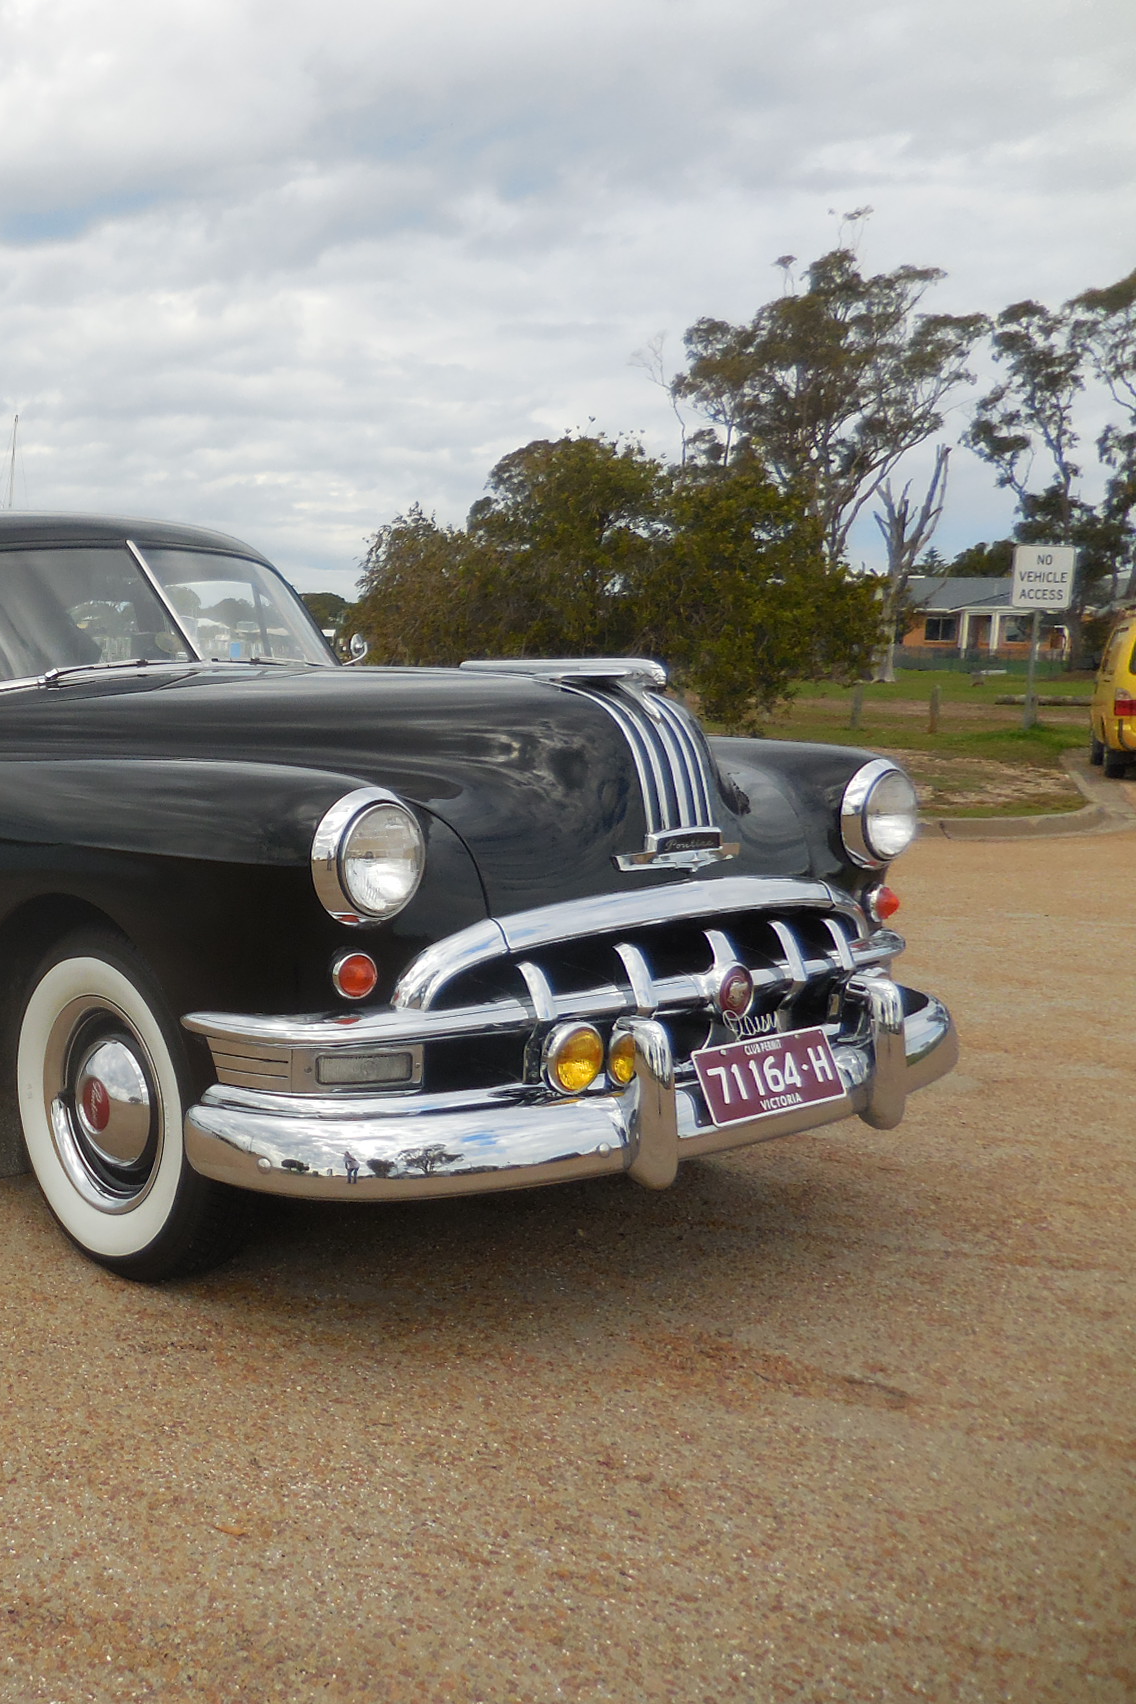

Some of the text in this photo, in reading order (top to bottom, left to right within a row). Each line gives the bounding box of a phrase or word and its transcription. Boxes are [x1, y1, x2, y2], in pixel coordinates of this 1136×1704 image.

[1036, 554, 1053, 566] NO
[1019, 571, 1068, 584] VEHICLE
[1019, 589, 1064, 600] ACCESS
[664, 838, 714, 852] Pontiac
[744, 1039, 782, 1056] CLUB PERMIT
[760, 1092, 803, 1111] VICTORIA
